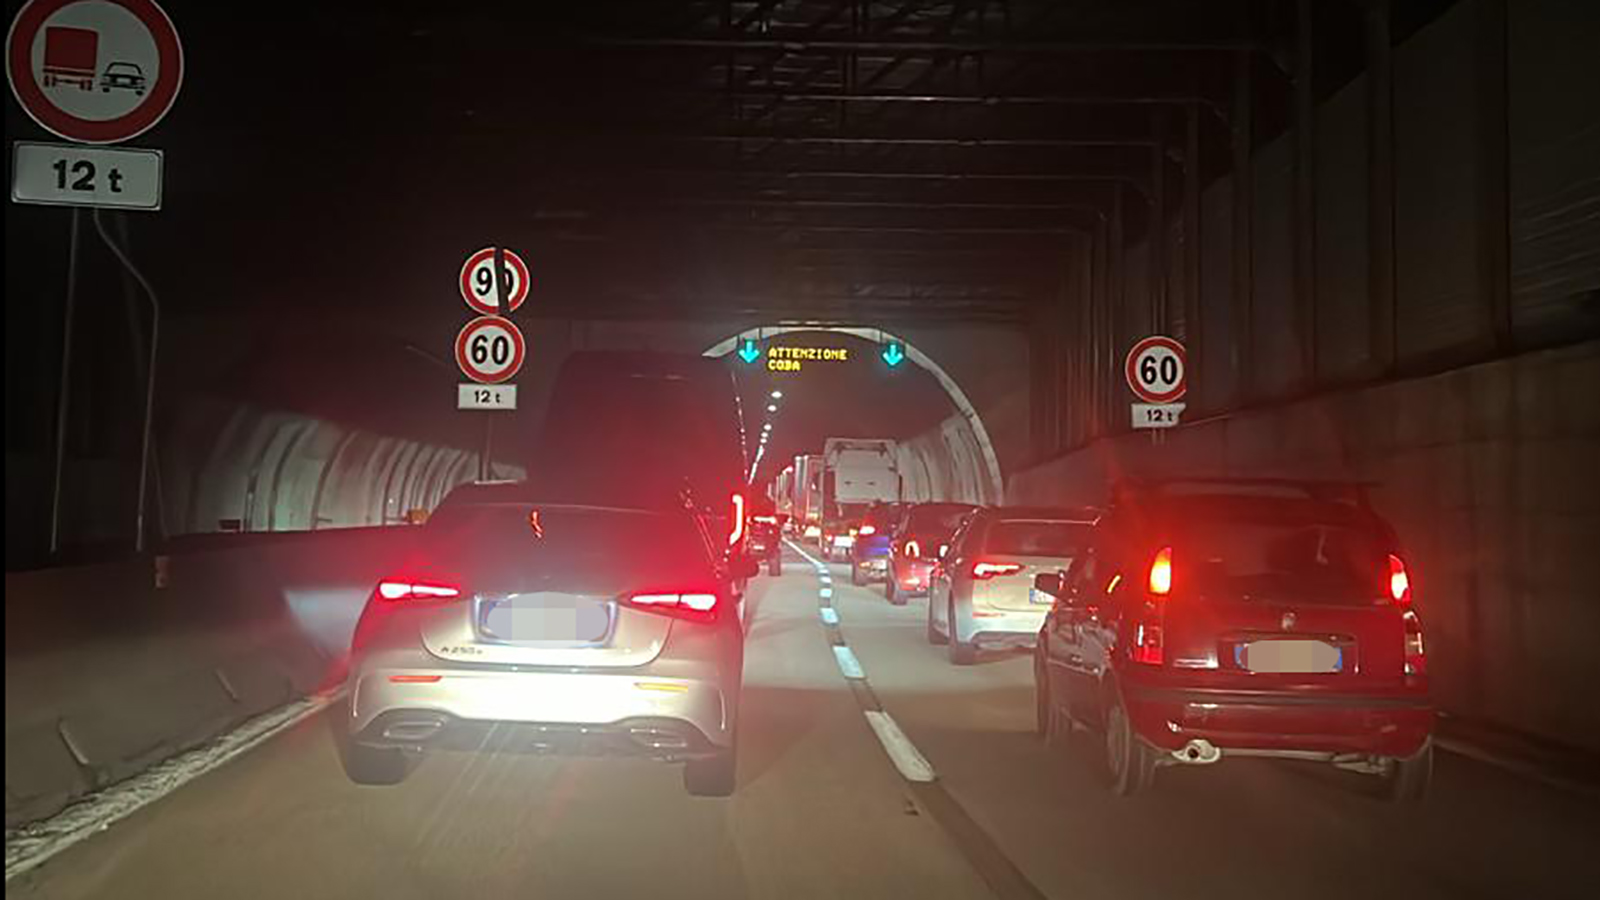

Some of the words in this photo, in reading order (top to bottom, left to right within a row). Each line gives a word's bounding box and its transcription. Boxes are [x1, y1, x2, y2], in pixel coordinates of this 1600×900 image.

[53, 159, 96, 191] 12
[108, 168, 123, 193] t
[471, 335, 509, 365] 60
[767, 346, 848, 360] ATTENZIONE
[1140, 355, 1178, 385] 60
[474, 390, 491, 403] 12
[495, 393, 502, 404] t
[1146, 409, 1163, 422] 12
[1166, 411, 1173, 422] t
